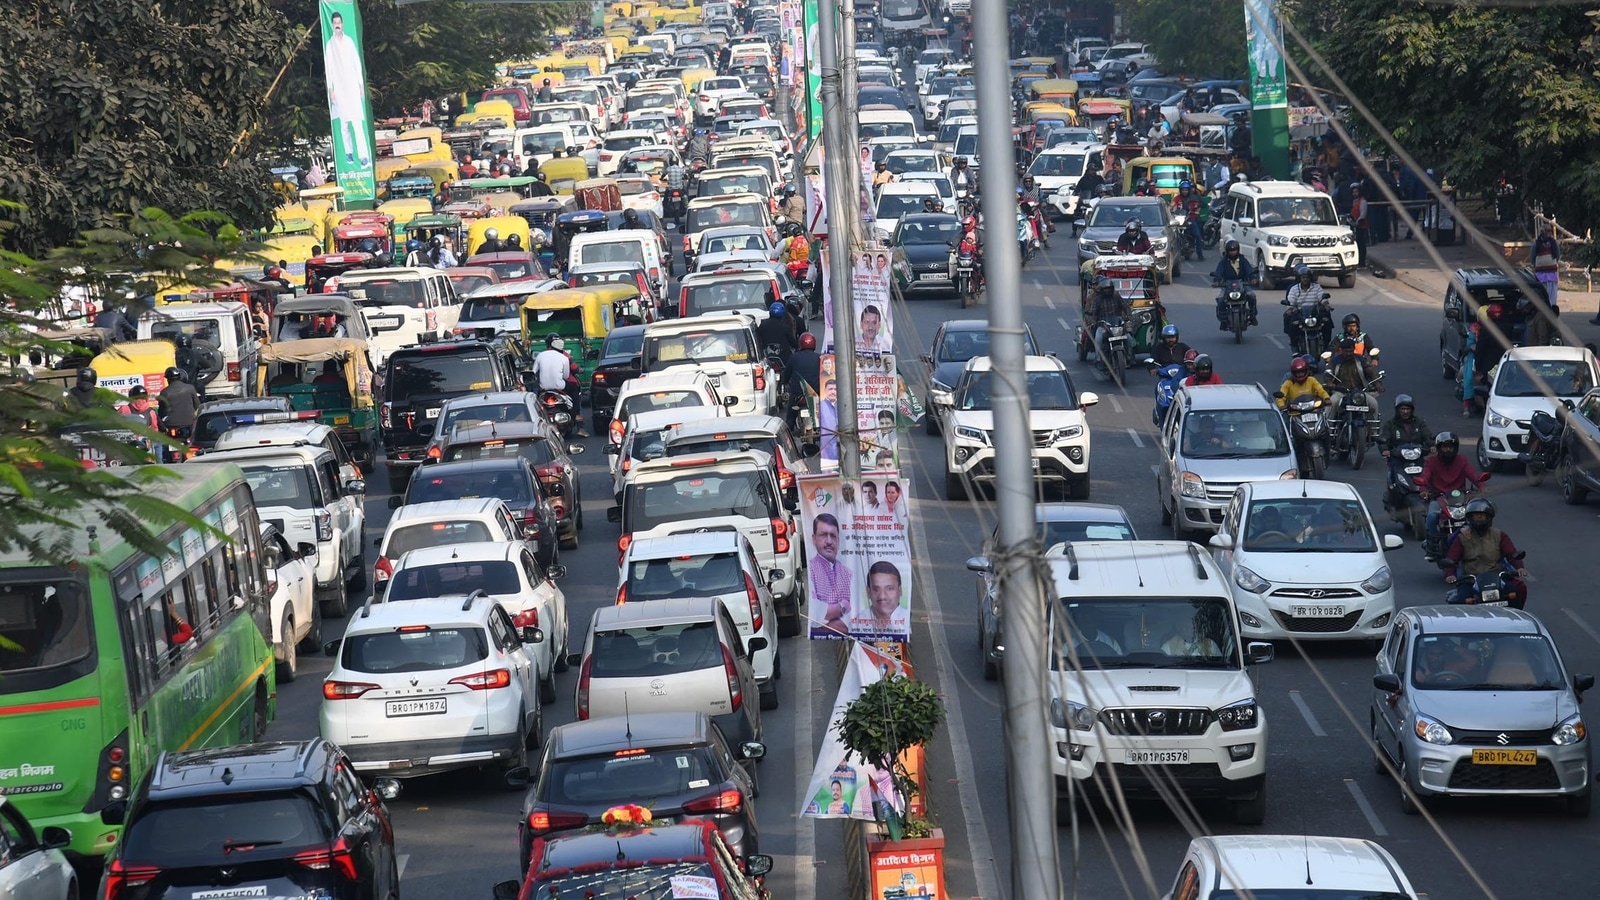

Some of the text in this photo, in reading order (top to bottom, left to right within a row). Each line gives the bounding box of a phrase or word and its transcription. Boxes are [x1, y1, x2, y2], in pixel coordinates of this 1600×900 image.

[392, 701, 446, 713] BR01PM1874
[61, 718, 86, 731] CNG
[1131, 752, 1188, 762] BR01PG3578
[1479, 752, 1535, 762] BR01PL4247
[20, 763, 55, 777] निगम
[6, 783, 62, 795] Marcopolo
